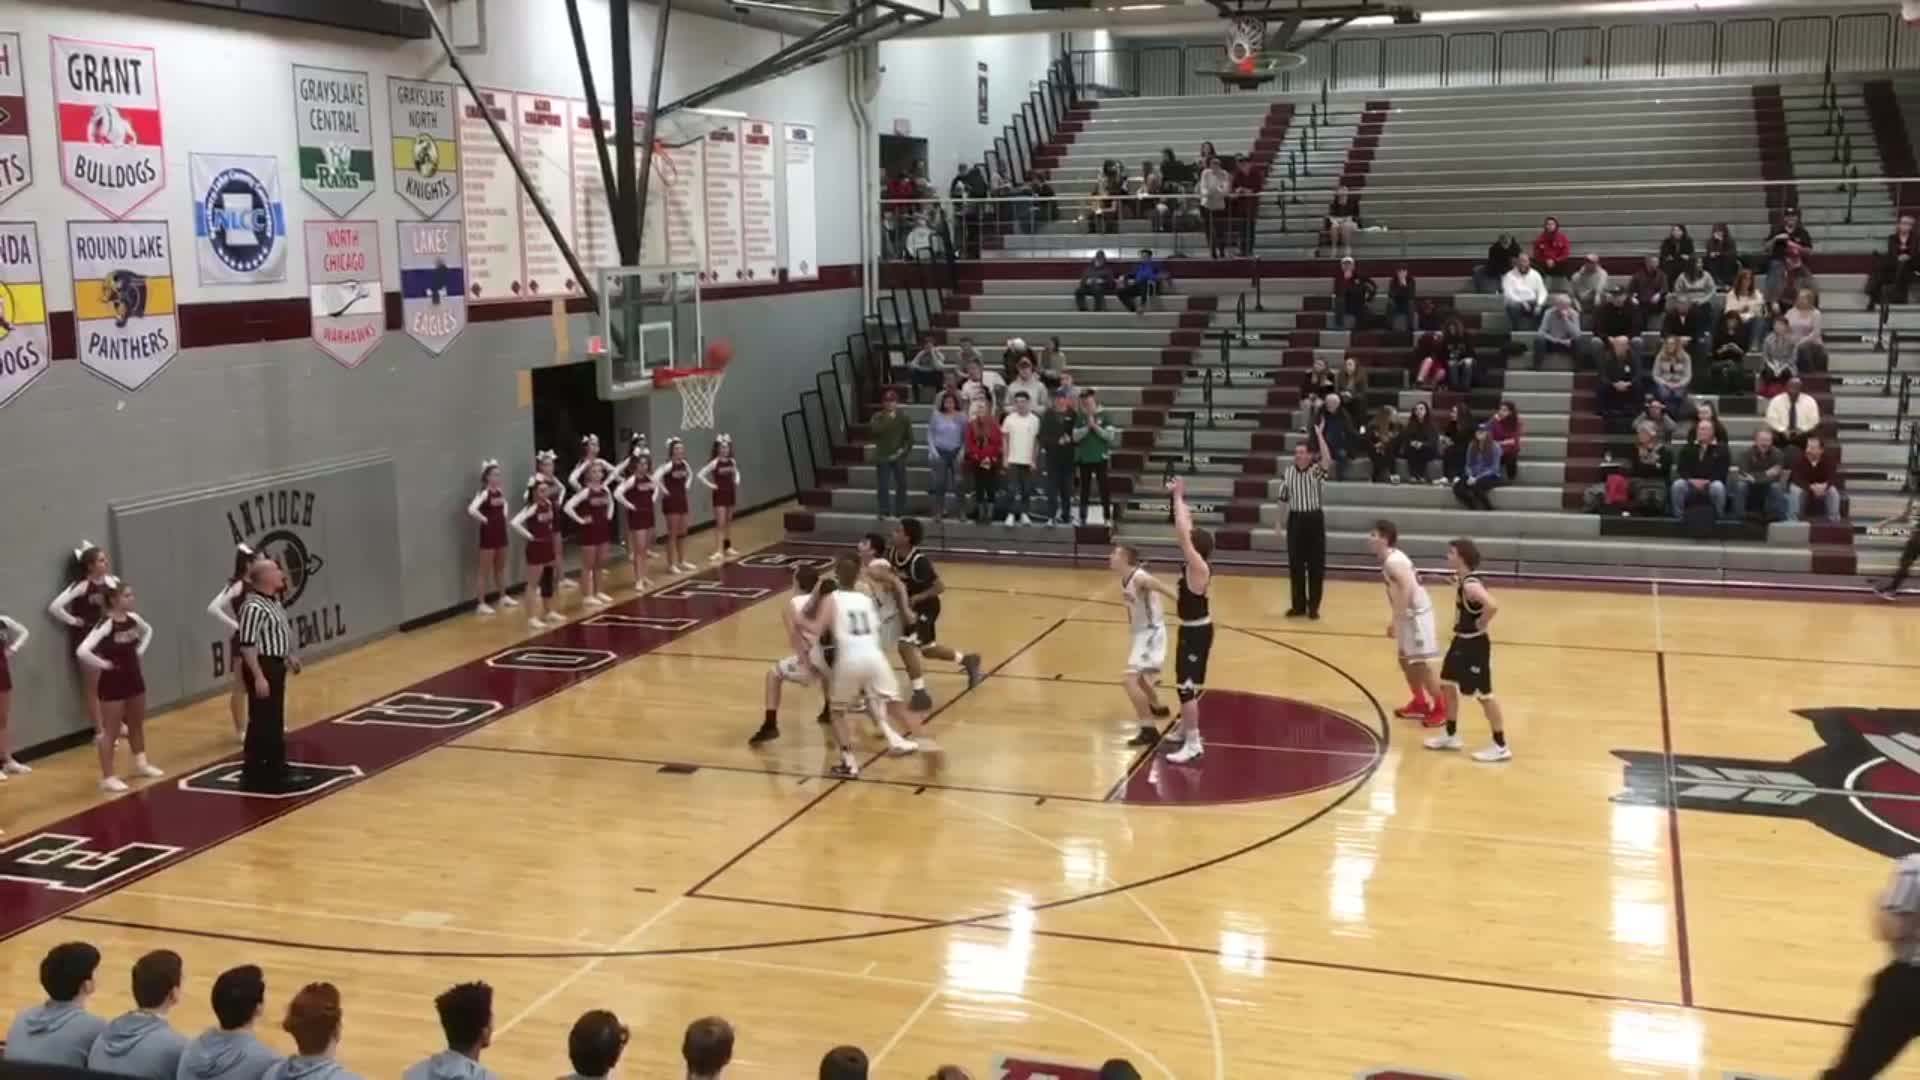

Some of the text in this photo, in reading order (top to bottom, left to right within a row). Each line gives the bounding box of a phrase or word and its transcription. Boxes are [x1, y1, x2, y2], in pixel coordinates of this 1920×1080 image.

[67, 53, 141, 95] GRANT
[300, 78, 364, 106] GRAYSLAKE
[398, 85, 446, 108] GRAYSLAKE
[309, 108, 360, 133] CENTRAL
[409, 111, 438, 129] NORTH
[74, 154, 156, 188] BULLDOGS
[406, 176, 450, 200] KNIGHTS
[77, 235, 165, 260] ROUND LAKE
[326, 229, 359, 248] NORTH
[412, 228, 449, 253] LAKES
[323, 252, 365, 272] CHICAGO
[323, 322, 376, 345] WARHAWKS
[413, 310, 456, 337] EAGLES
[88, 328, 169, 361] PANTHERS
[227, 489, 315, 544] ANTIOCH
[846, 610, 872, 635] 11
